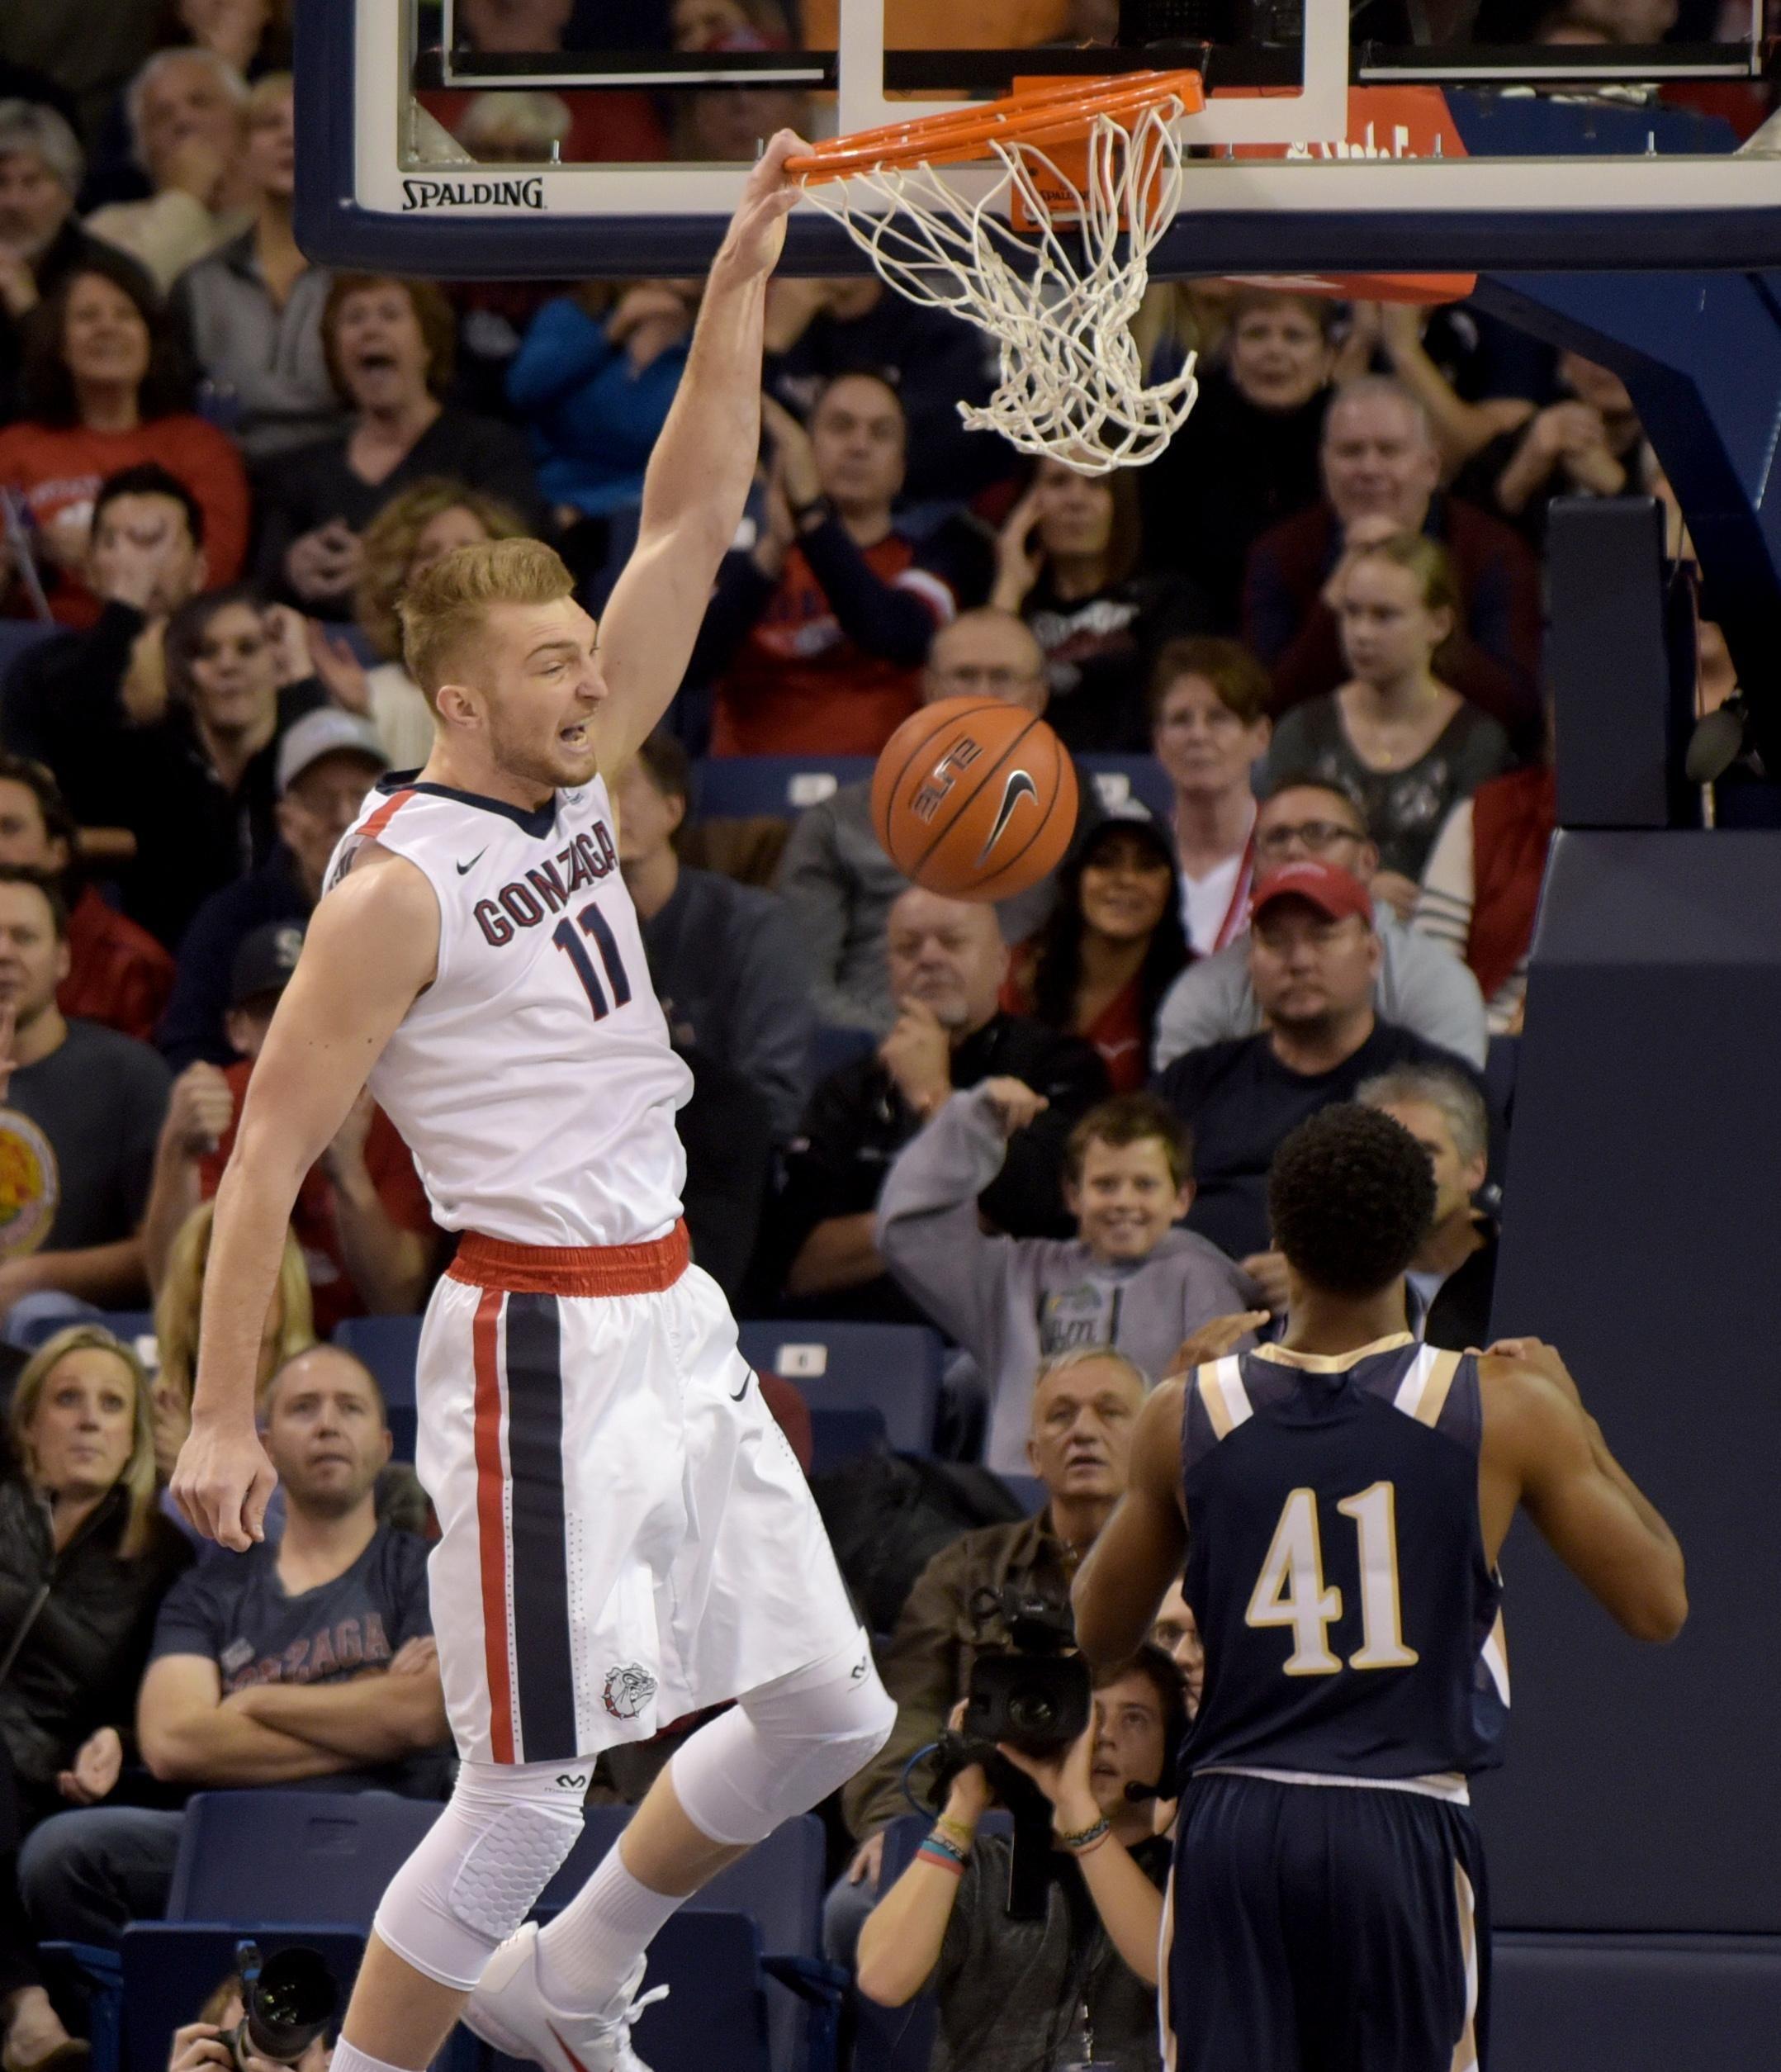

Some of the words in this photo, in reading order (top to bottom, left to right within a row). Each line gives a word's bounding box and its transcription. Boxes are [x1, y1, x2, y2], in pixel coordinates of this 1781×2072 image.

[402, 177, 543, 211] SPALDING
[1041, 189, 1091, 201] SPALN
[552, 902, 632, 1022] 11
[1245, 1481, 1419, 1676] 41
[221, 1611, 393, 1691] ZAGA
